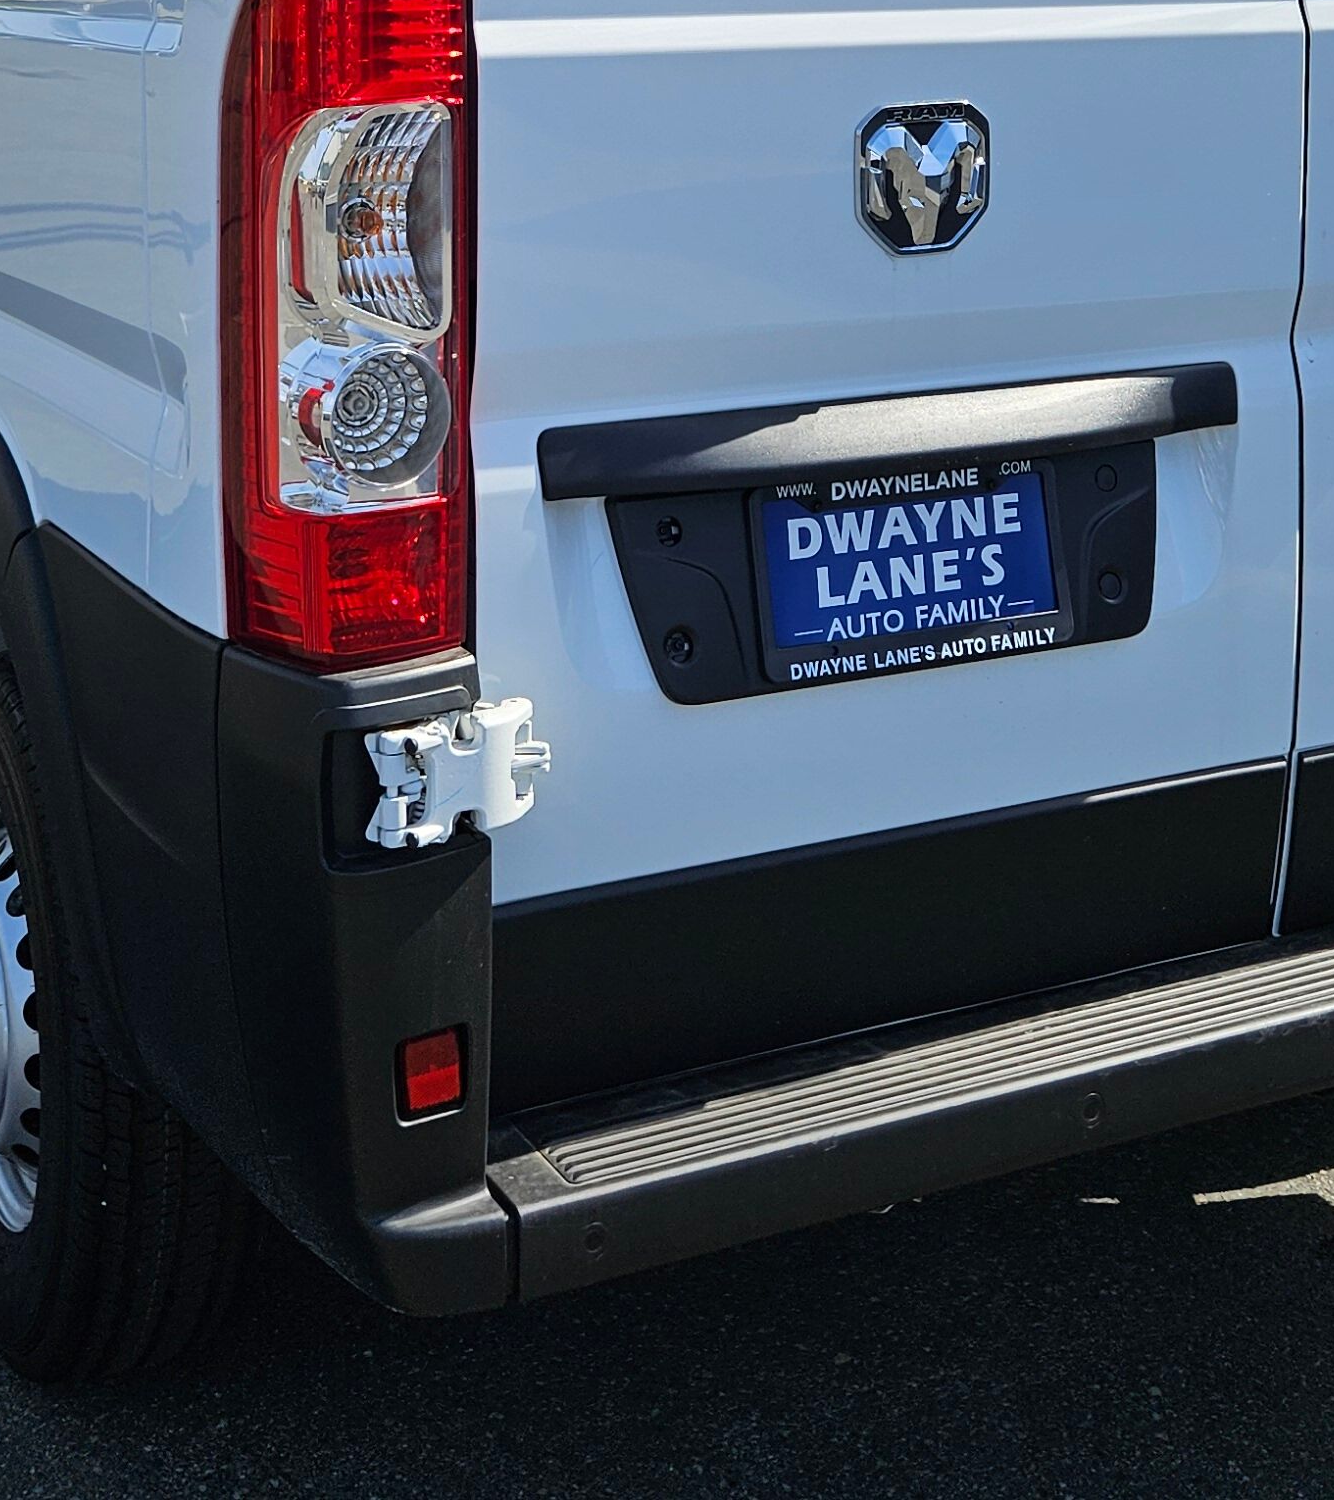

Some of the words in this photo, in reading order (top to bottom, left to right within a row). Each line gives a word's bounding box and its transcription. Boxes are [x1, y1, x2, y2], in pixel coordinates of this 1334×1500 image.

[886, 103, 965, 122] RAM
[776, 482, 817, 498] WWW.
[831, 468, 979, 501] DWAYNELANE
[998, 460, 1031, 476] .COM
[787, 492, 1021, 561] DWAYNE
[816, 544, 1005, 609] LANE'S
[826, 610, 904, 642] AUTO
[915, 594, 1005, 629] FAMILY
[790, 654, 867, 681] DWAYNE
[874, 644, 937, 669] LANE'S
[940, 636, 986, 660] AUTO
[991, 627, 1056, 652] FAMILY
